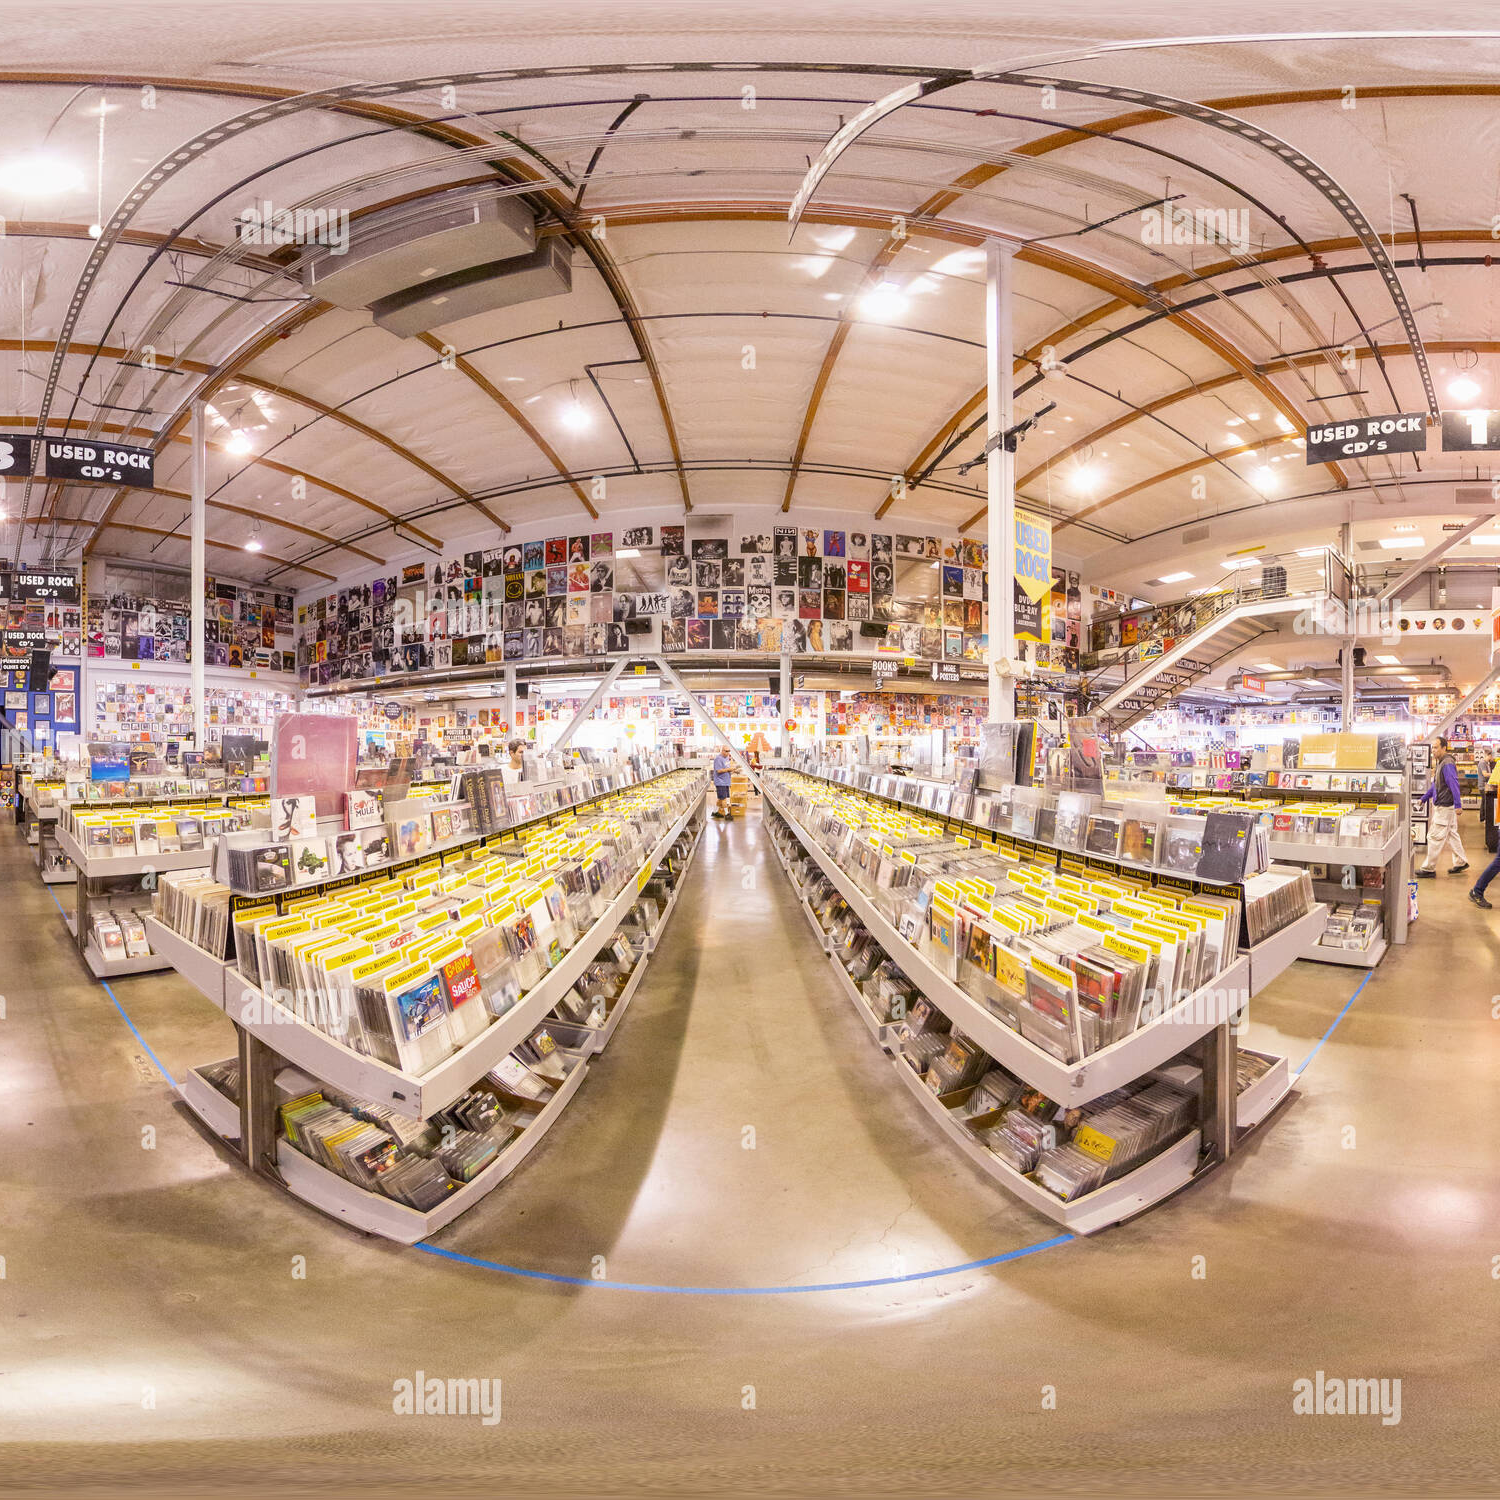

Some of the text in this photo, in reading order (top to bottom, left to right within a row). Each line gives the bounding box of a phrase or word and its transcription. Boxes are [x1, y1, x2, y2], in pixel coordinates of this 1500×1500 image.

[1310, 418, 1422, 445] USED ROCK
[1465, 413, 1488, 445] 1
[1342, 440, 1388, 454] CD's
[49, 444, 151, 470] USED ROCK
[80, 465, 122, 481] CD's
[1015, 520, 1050, 555] USED
[1015, 548, 1051, 584] ROCK
[19, 575, 74, 587] USED ROCK
[505, 573, 524, 582] NIRVANA
[35, 588, 58, 597] CD's
[1014, 603, 1038, 616] BLU-RAY
[8, 631, 44, 640] USED ROCK
[662, 642, 685, 651] NIRVANA
[872, 660, 898, 671] BOOKS
[943, 664, 957, 673] MORE
[939, 672, 960, 682] POSTERS
[1154, 672, 1178, 684] DANCE
[1136, 687, 1158, 698] HIP HOP
[1118, 701, 1141, 710] SOUL
[355, 807, 375, 818] MULE
[1123, 867, 1149, 880] Used Rock
[326, 878, 353, 889] Used Rock
[1160, 877, 1190, 889] Used Rock
[285, 887, 315, 899] Used Rock
[1204, 885, 1237, 897] Used Rock
[237, 895, 272, 907] Used Rock
